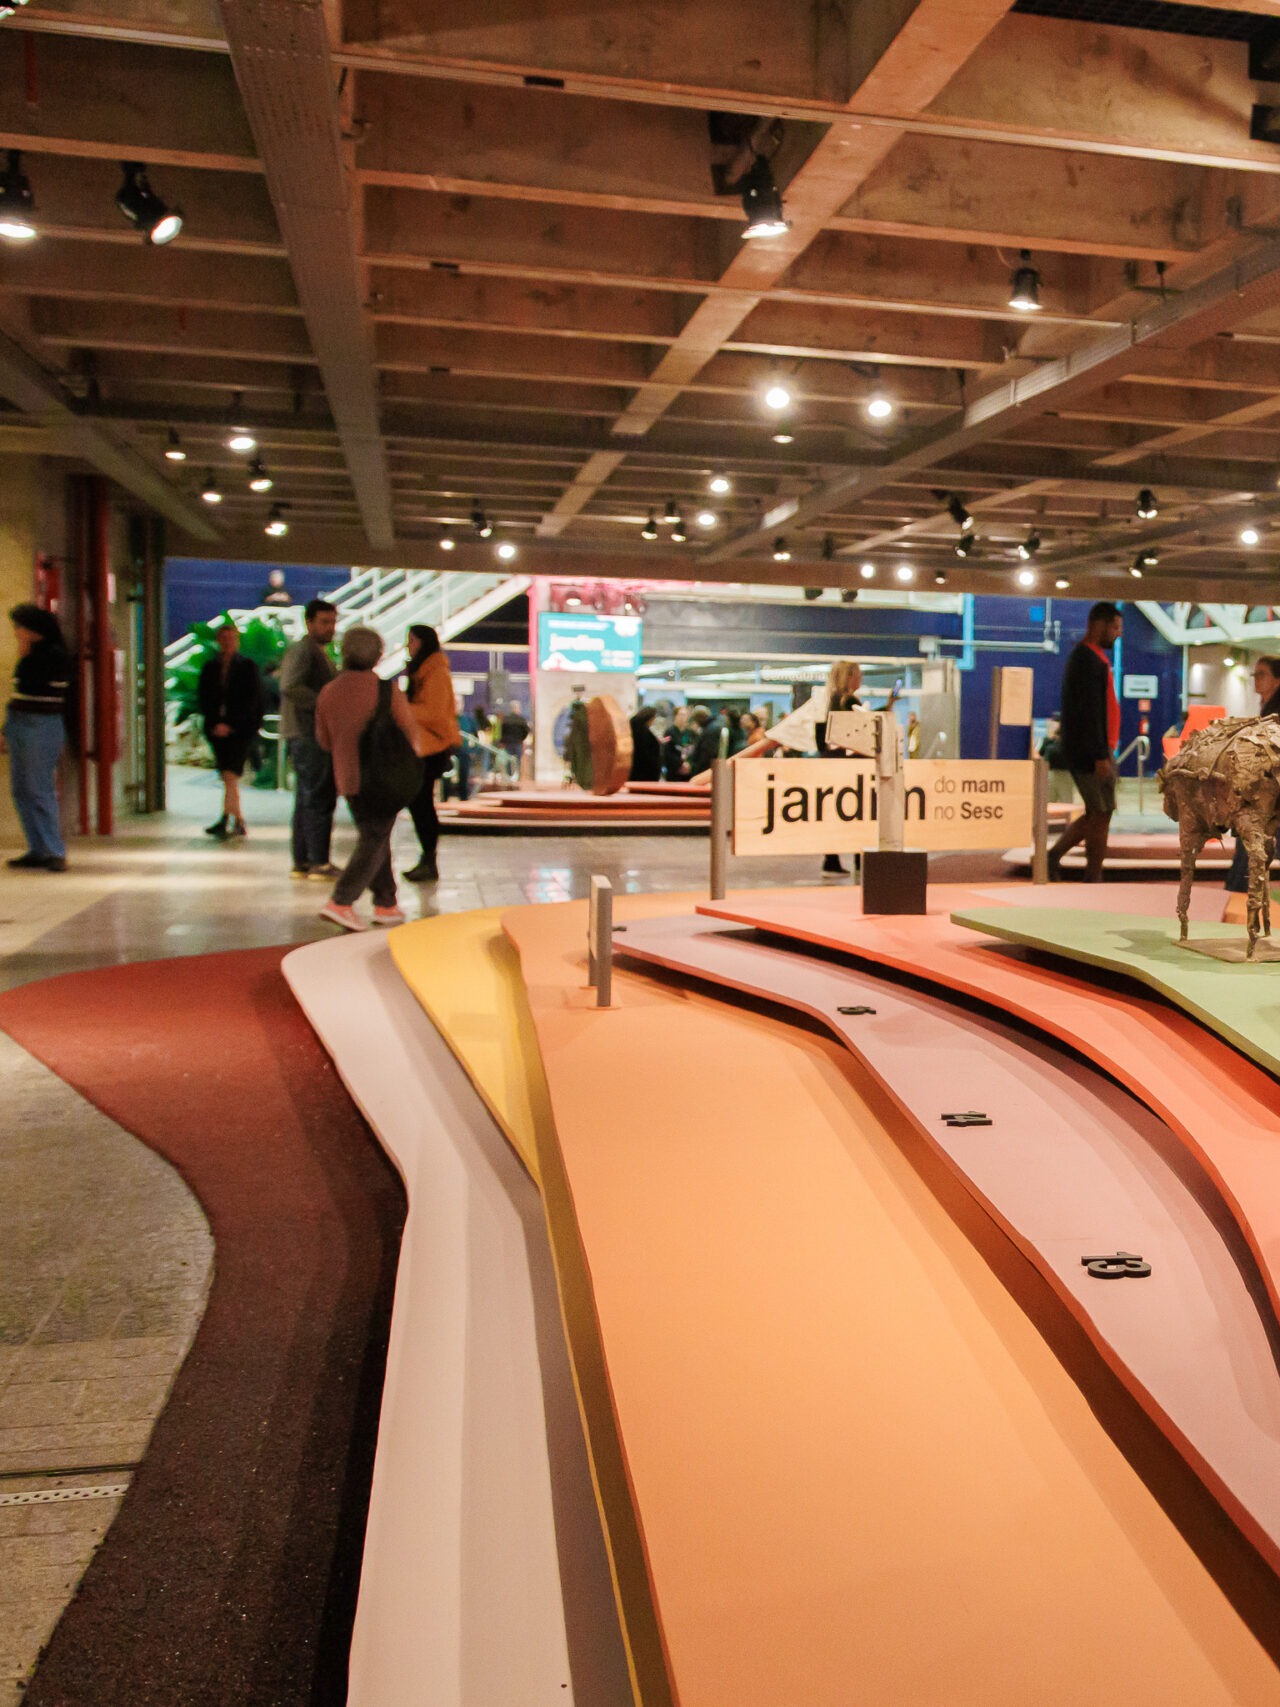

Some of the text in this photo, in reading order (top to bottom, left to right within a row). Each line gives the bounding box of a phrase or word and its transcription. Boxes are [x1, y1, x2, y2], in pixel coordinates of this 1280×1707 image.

[934, 775, 1006, 794] do mam
[934, 801, 1004, 820] no Sesc
